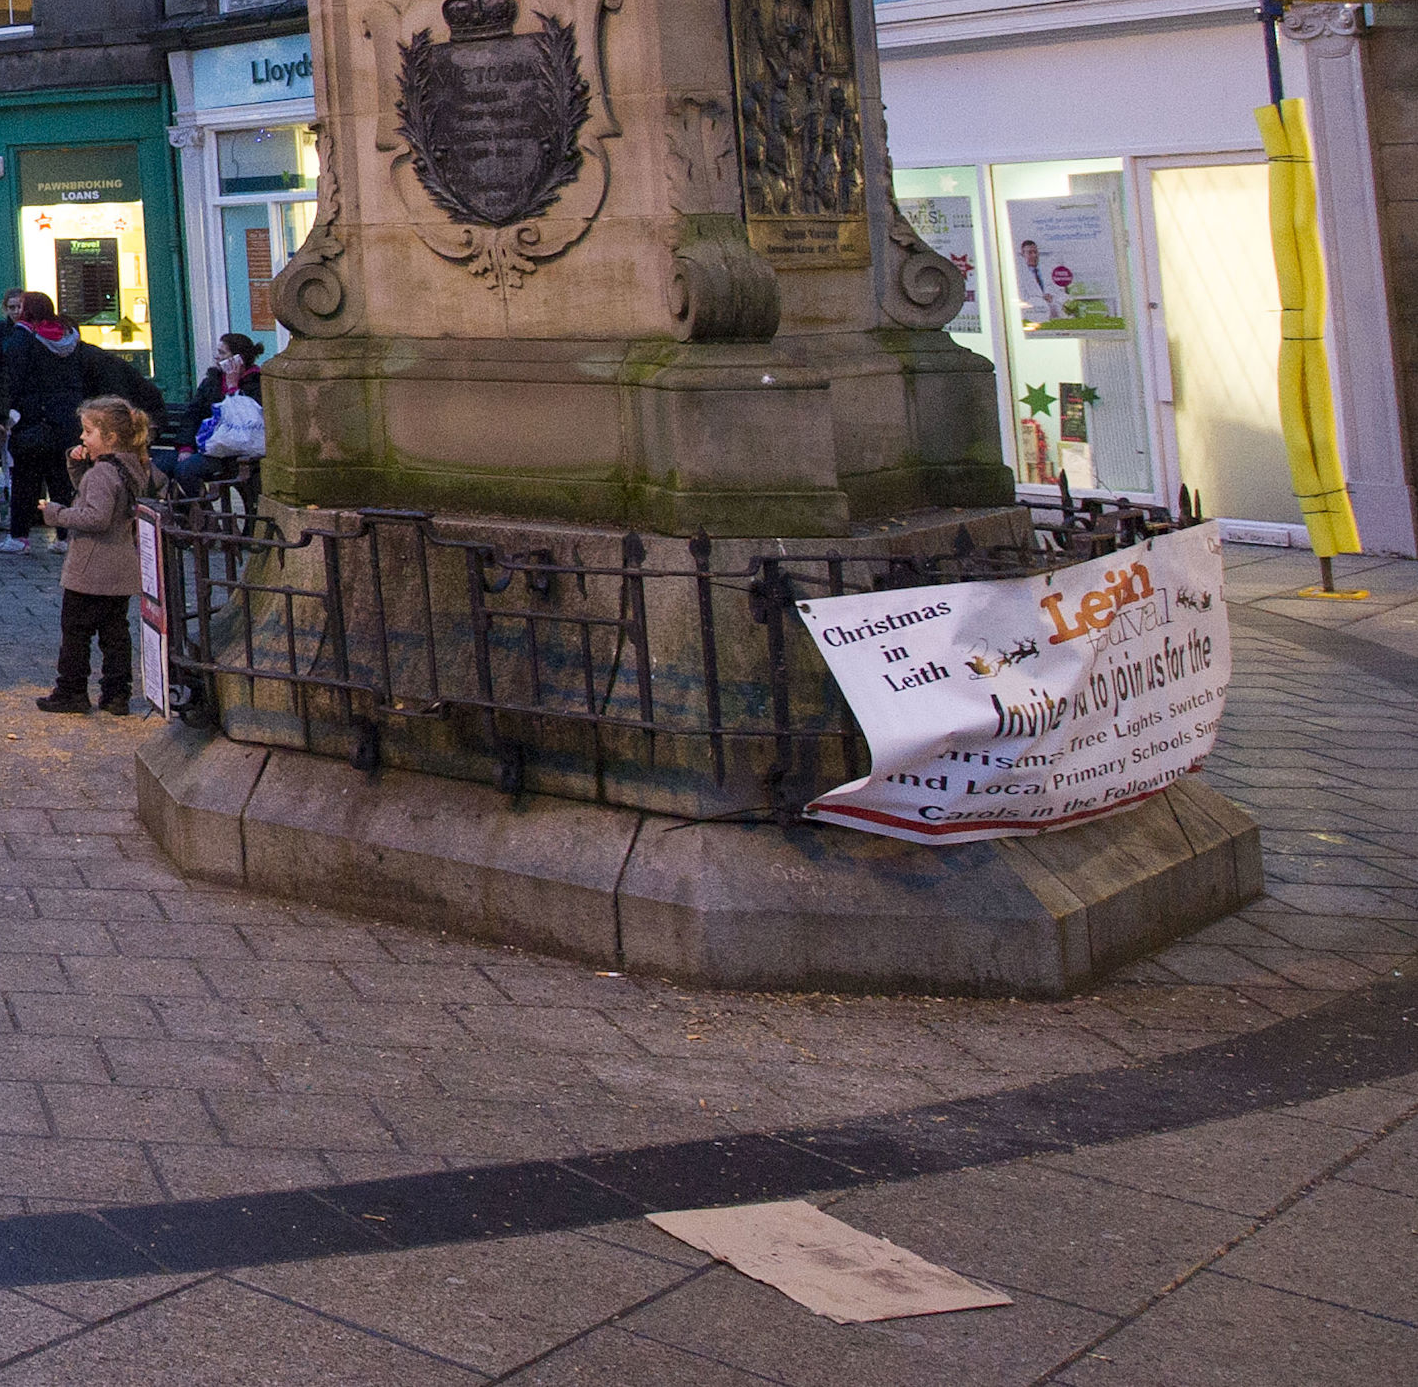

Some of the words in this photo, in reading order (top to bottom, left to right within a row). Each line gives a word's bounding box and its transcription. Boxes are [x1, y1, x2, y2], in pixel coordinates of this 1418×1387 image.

[37, 179, 124, 192] PAWNBROKING
[61, 190, 101, 202] LOANS
[70, 240, 101, 249] Travel
[822, 600, 953, 648] Christmas
[880, 644, 911, 664] in
[882, 661, 951, 693] Leith
[991, 688, 1067, 739] Invite
[1089, 671, 1108, 711] to
[1109, 651, 1144, 717] join
[1147, 652, 1166, 692] us
[1164, 636, 1184, 683] for
[1188, 628, 1212, 674] the
[1070, 730, 1108, 753] Tree
[1113, 711, 1163, 739] Lights
[1168, 688, 1214, 719] Switch
[1052, 755, 1127, 791] Primary
[1131, 730, 1193, 765] Schools
[917, 804, 1023, 822] Carols
[1031, 804, 1054, 818] in
[1062, 796, 1097, 814] the
